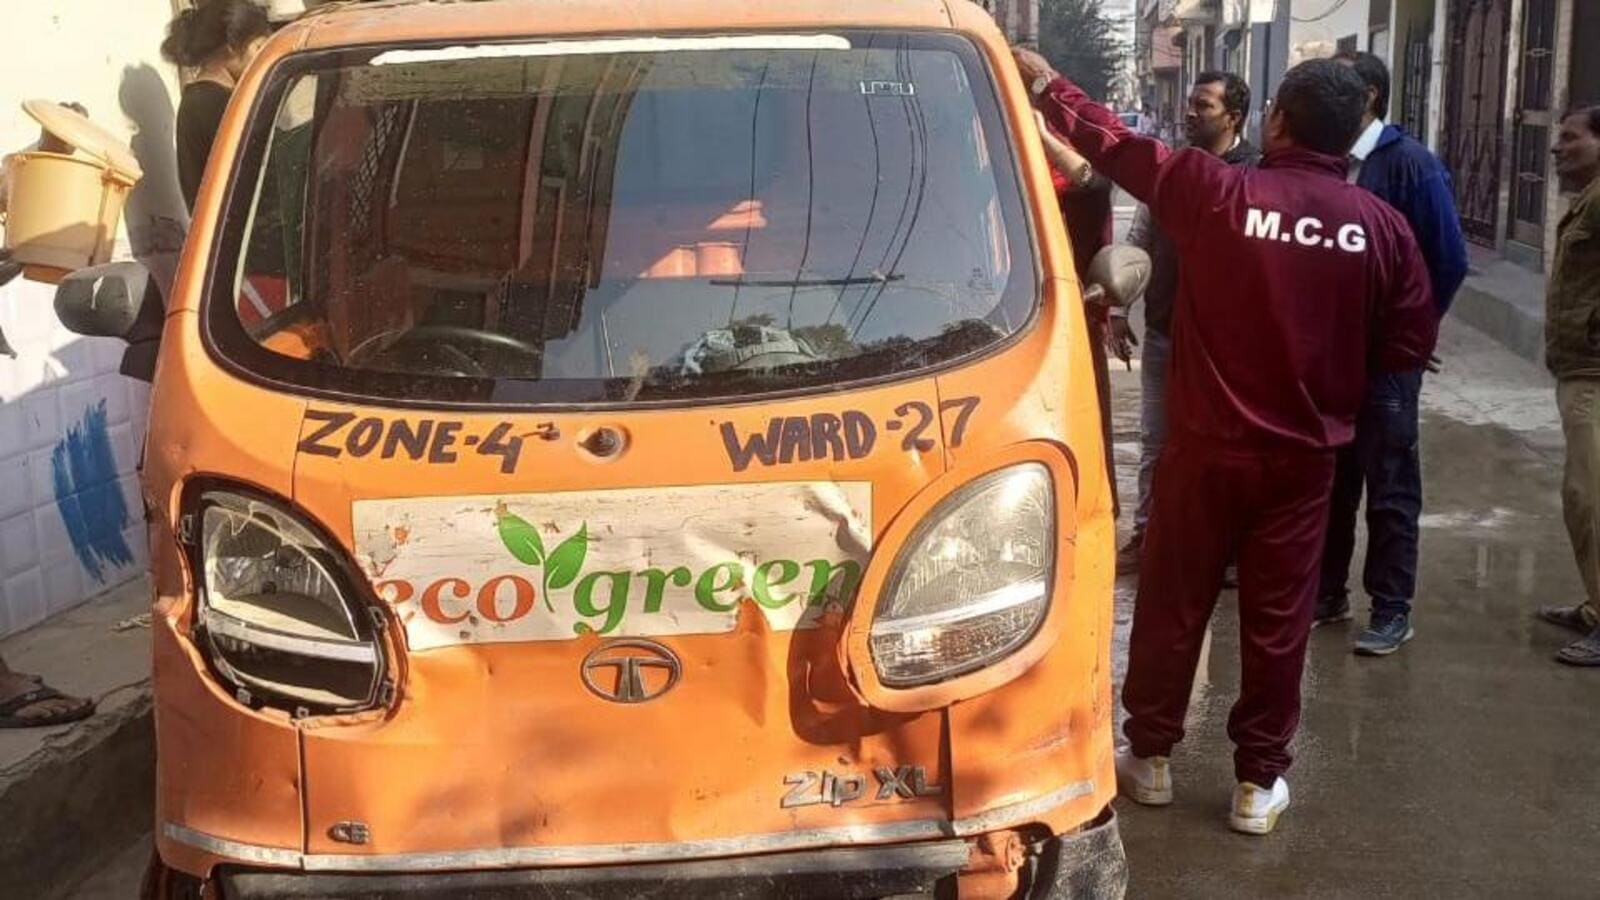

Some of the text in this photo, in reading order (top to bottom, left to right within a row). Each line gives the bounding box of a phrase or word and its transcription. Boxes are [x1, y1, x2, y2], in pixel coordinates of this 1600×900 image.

[1244, 207, 1367, 253] M.C.G
[572, 556, 861, 635] green
[873, 765, 944, 800] XL
